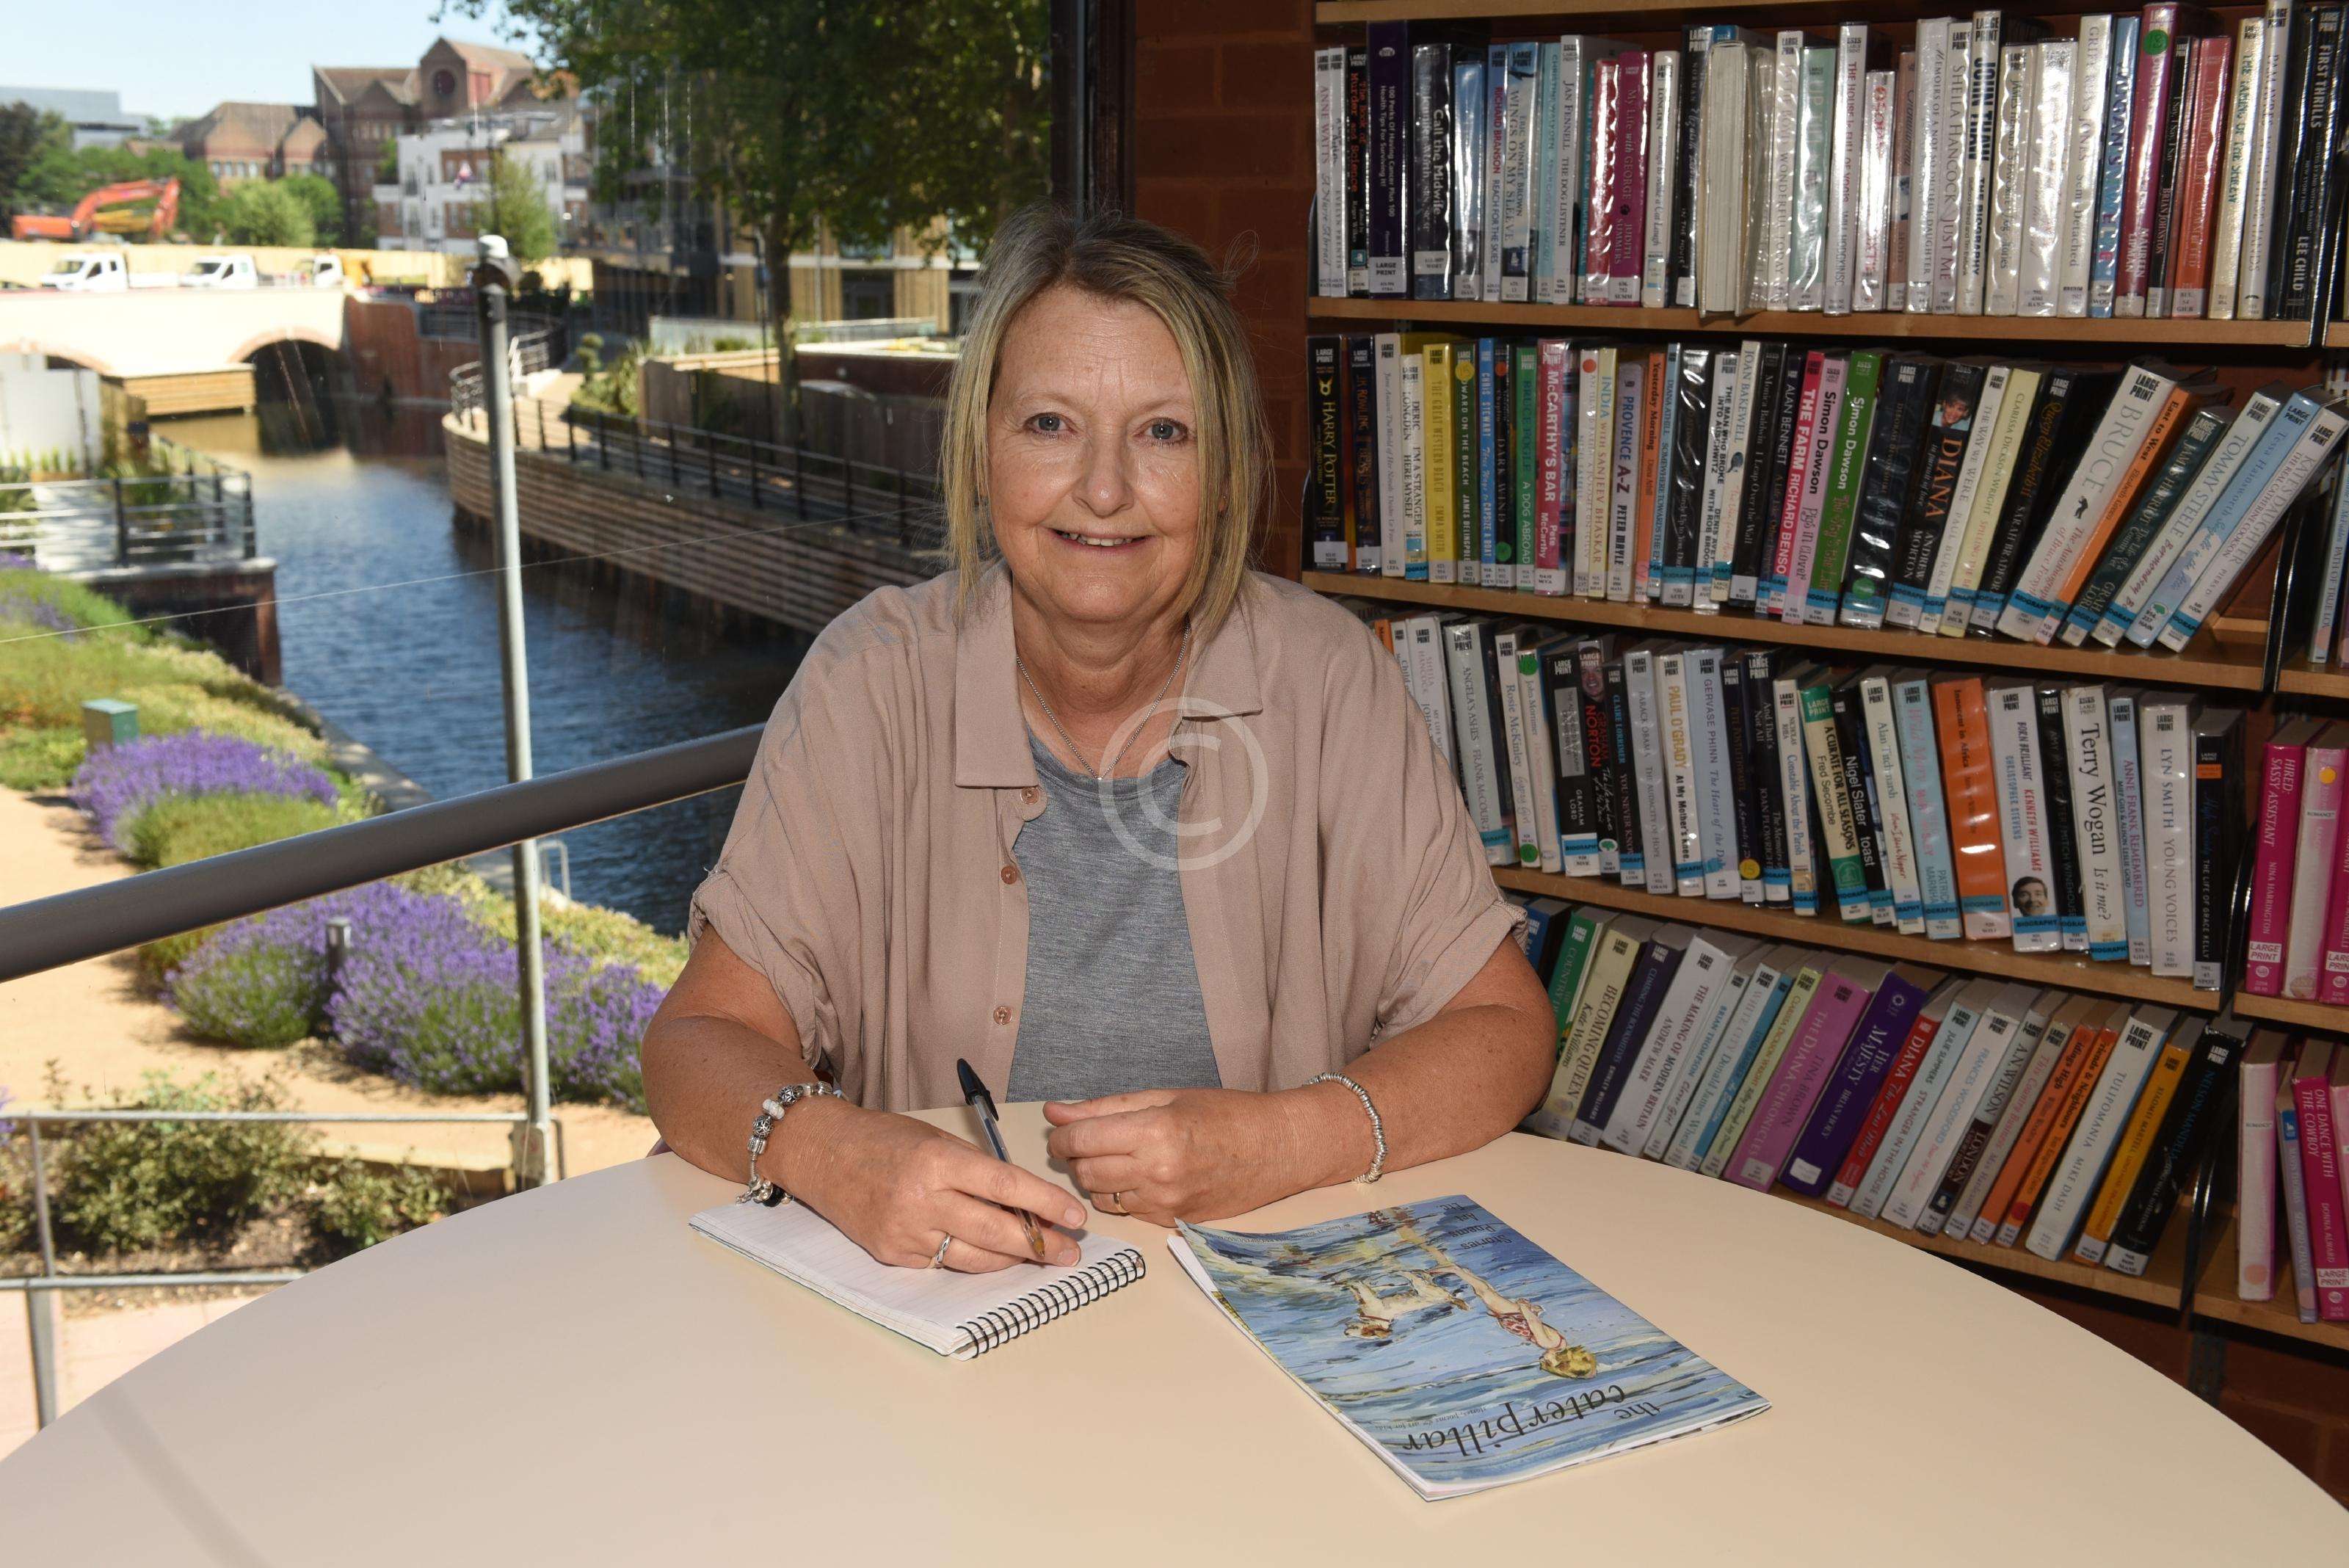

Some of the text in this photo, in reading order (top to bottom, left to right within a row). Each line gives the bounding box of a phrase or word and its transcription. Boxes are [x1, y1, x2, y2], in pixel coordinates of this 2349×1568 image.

[1968, 57, 1997, 161] JOHN THAW
[2310, 44, 2331, 128] FIRST THRILLS
[1386, 134, 1395, 159] Having
[1387, 122, 1395, 131] Of
[1432, 109, 1443, 137] Call
[1432, 142, 1442, 161] the
[1492, 87, 1503, 174] RICHARD BRANSON
[1622, 90, 1636, 200] My Life with GEORGE
[1504, 91, 1519, 241] WINGS ON MY SLEEVE
[1558, 80, 1573, 247] JAN FENNELL THE DOG LISTENER
[1940, 65, 1964, 280] SHEILA HANCOCK JUST ME
[1614, 218, 1623, 264] SUMMERS
[1623, 223, 1633, 259] JUDITH
[1776, 153, 1788, 274] WONDERFUL TODAY
[2297, 236, 2309, 255] LEE
[2292, 258, 2307, 291] CHILD
[1402, 391, 1411, 440] LONGDEN
[1462, 416, 1467, 430] ON
[1481, 372, 1491, 437] CHRIS STEWART
[1600, 376, 1612, 419] INDIA
[1777, 384, 1796, 465] ALAN BENNETT
[1323, 402, 1336, 505] HARRY POTTER
[1413, 446, 1421, 464] I'M
[1544, 371, 1559, 501] McCARTHY'S BAR
[1599, 422, 1607, 448] WITH
[1783, 389, 1816, 529] THE FARM RICHARD
[1809, 391, 1837, 495] Simon Dawson
[1838, 396, 1865, 490] Simon Dawson
[2079, 402, 2144, 496] BRUCE
[1404, 454, 1412, 518] HERE MYSELF
[1413, 476, 1422, 526] STRANGER
[1595, 451, 1607, 504] SANJEEV
[1614, 396, 1634, 565] PROVENCE A-Z PETER MAYLE
[1925, 437, 1962, 518] DIANA
[2170, 428, 2248, 540] TOMMY STEELE
[1483, 502, 1492, 529] CAPSIZE
[1484, 540, 1492, 557] BOAT
[1522, 482, 1531, 564] A DOG ABROAD
[1539, 512, 1548, 559] McCarthy
[1549, 525, 1557, 545] Pete
[1593, 508, 1604, 564] BHASKAR
[1903, 529, 1923, 578] MORTON
[1915, 531, 1935, 581] ANDREW
[1462, 666, 1480, 741] ANGELA'S ASHES
[1506, 684, 1522, 767] Rosie McKinley
[1586, 705, 1601, 768] NORTON
[1704, 678, 1718, 764] GERVASE PHINN
[1668, 685, 1689, 862] PAUL O'GRADY At My Mother's Knee.
[1816, 755, 1837, 826] Fred Secombe
[2263, 758, 2282, 846] SASSY ASSISTANT
[2281, 758, 2295, 795] HIRED:
[1845, 755, 1875, 866] Nigel Slater toast
[2078, 723, 2110, 921] Terry Wogan Is it me?
[2161, 748, 2178, 943] LYN SMITH YOUNG VOICES
[1566, 984, 1618, 1099] BECOMING QUEEN
[1635, 984, 1708, 1130] THE MAKING OF MODERN BRITAIN
[1747, 1009, 1828, 1159] THE DIANA CHRONICLES
[1984, 1042, 2027, 1117] A.N. WILSON
[1952, 1129, 1986, 1186] LONDON
[2052, 1068, 2127, 1213] TULIPOMANIA MIKE DASH
[2302, 1091, 2319, 1158] THE COWBOY
[2314, 1089, 2334, 1177] ONE DANCE WITH
[1448, 1224, 1496, 1238] Poems
[1460, 1235, 1512, 1249] Stories
[2319, 1269, 2347, 1278] LARGE
[2321, 1277, 2347, 1287] PRINT
[1402, 1385, 1626, 1457] caterpillar
[1613, 1401, 1661, 1420] the
